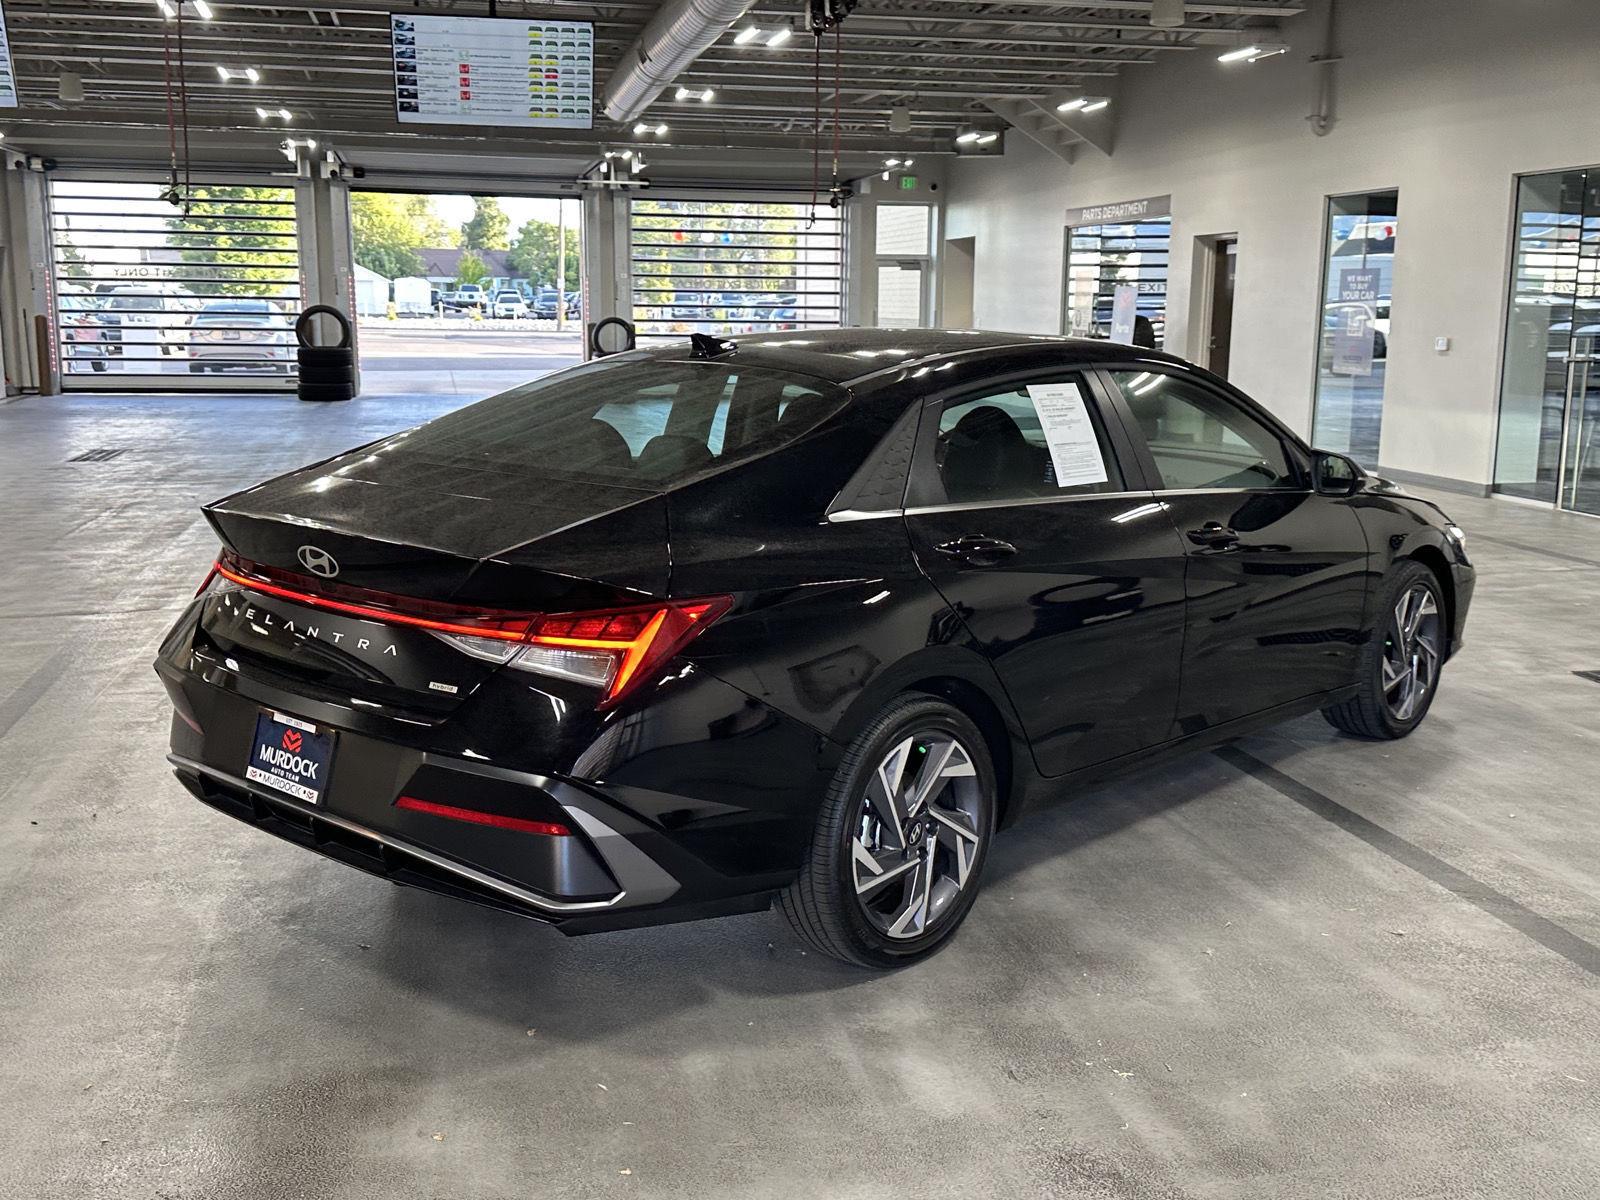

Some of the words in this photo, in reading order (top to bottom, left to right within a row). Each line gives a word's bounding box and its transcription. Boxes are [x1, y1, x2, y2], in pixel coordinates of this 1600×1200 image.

[1082, 207, 1102, 221] PARTS
[1102, 200, 1148, 218] DEPARTMENT
[1342, 290, 1360, 300] YOUR
[1360, 290, 1375, 300] CAR
[245, 608, 397, 656] ELANTRA
[259, 744, 319, 780] MURDOCK
[262, 774, 302, 795] MURDOCK
[270, 767, 285, 777] AUTO
[285, 772, 300, 782] TEAM
